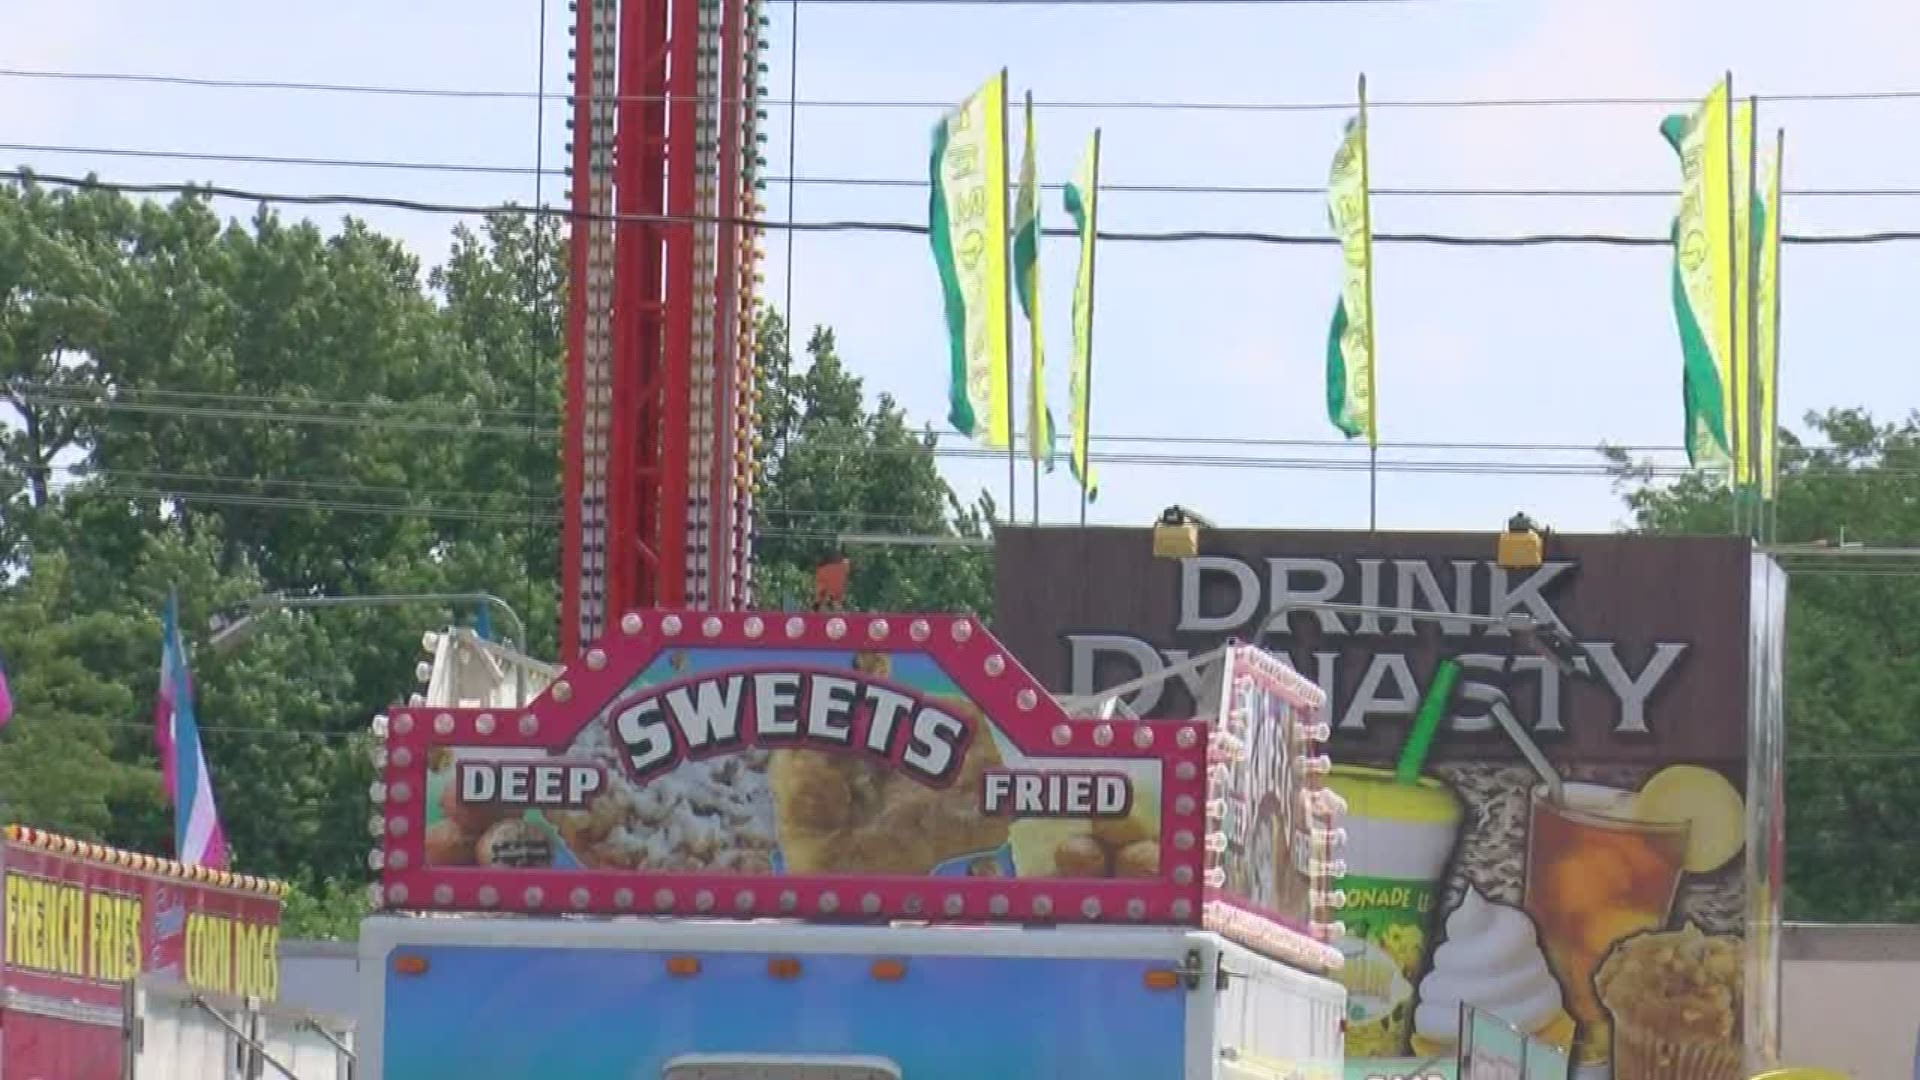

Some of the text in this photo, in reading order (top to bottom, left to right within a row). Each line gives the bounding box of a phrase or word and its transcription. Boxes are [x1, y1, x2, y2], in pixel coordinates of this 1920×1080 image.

[1178, 557, 1574, 638] DRINK
[615, 674, 965, 777] SWEETS
[460, 764, 602, 806] DEEP
[984, 773, 1128, 815] FRIED
[5, 874, 142, 981] FRENCH FRIES
[185, 912, 280, 1002] CORN DOGS
